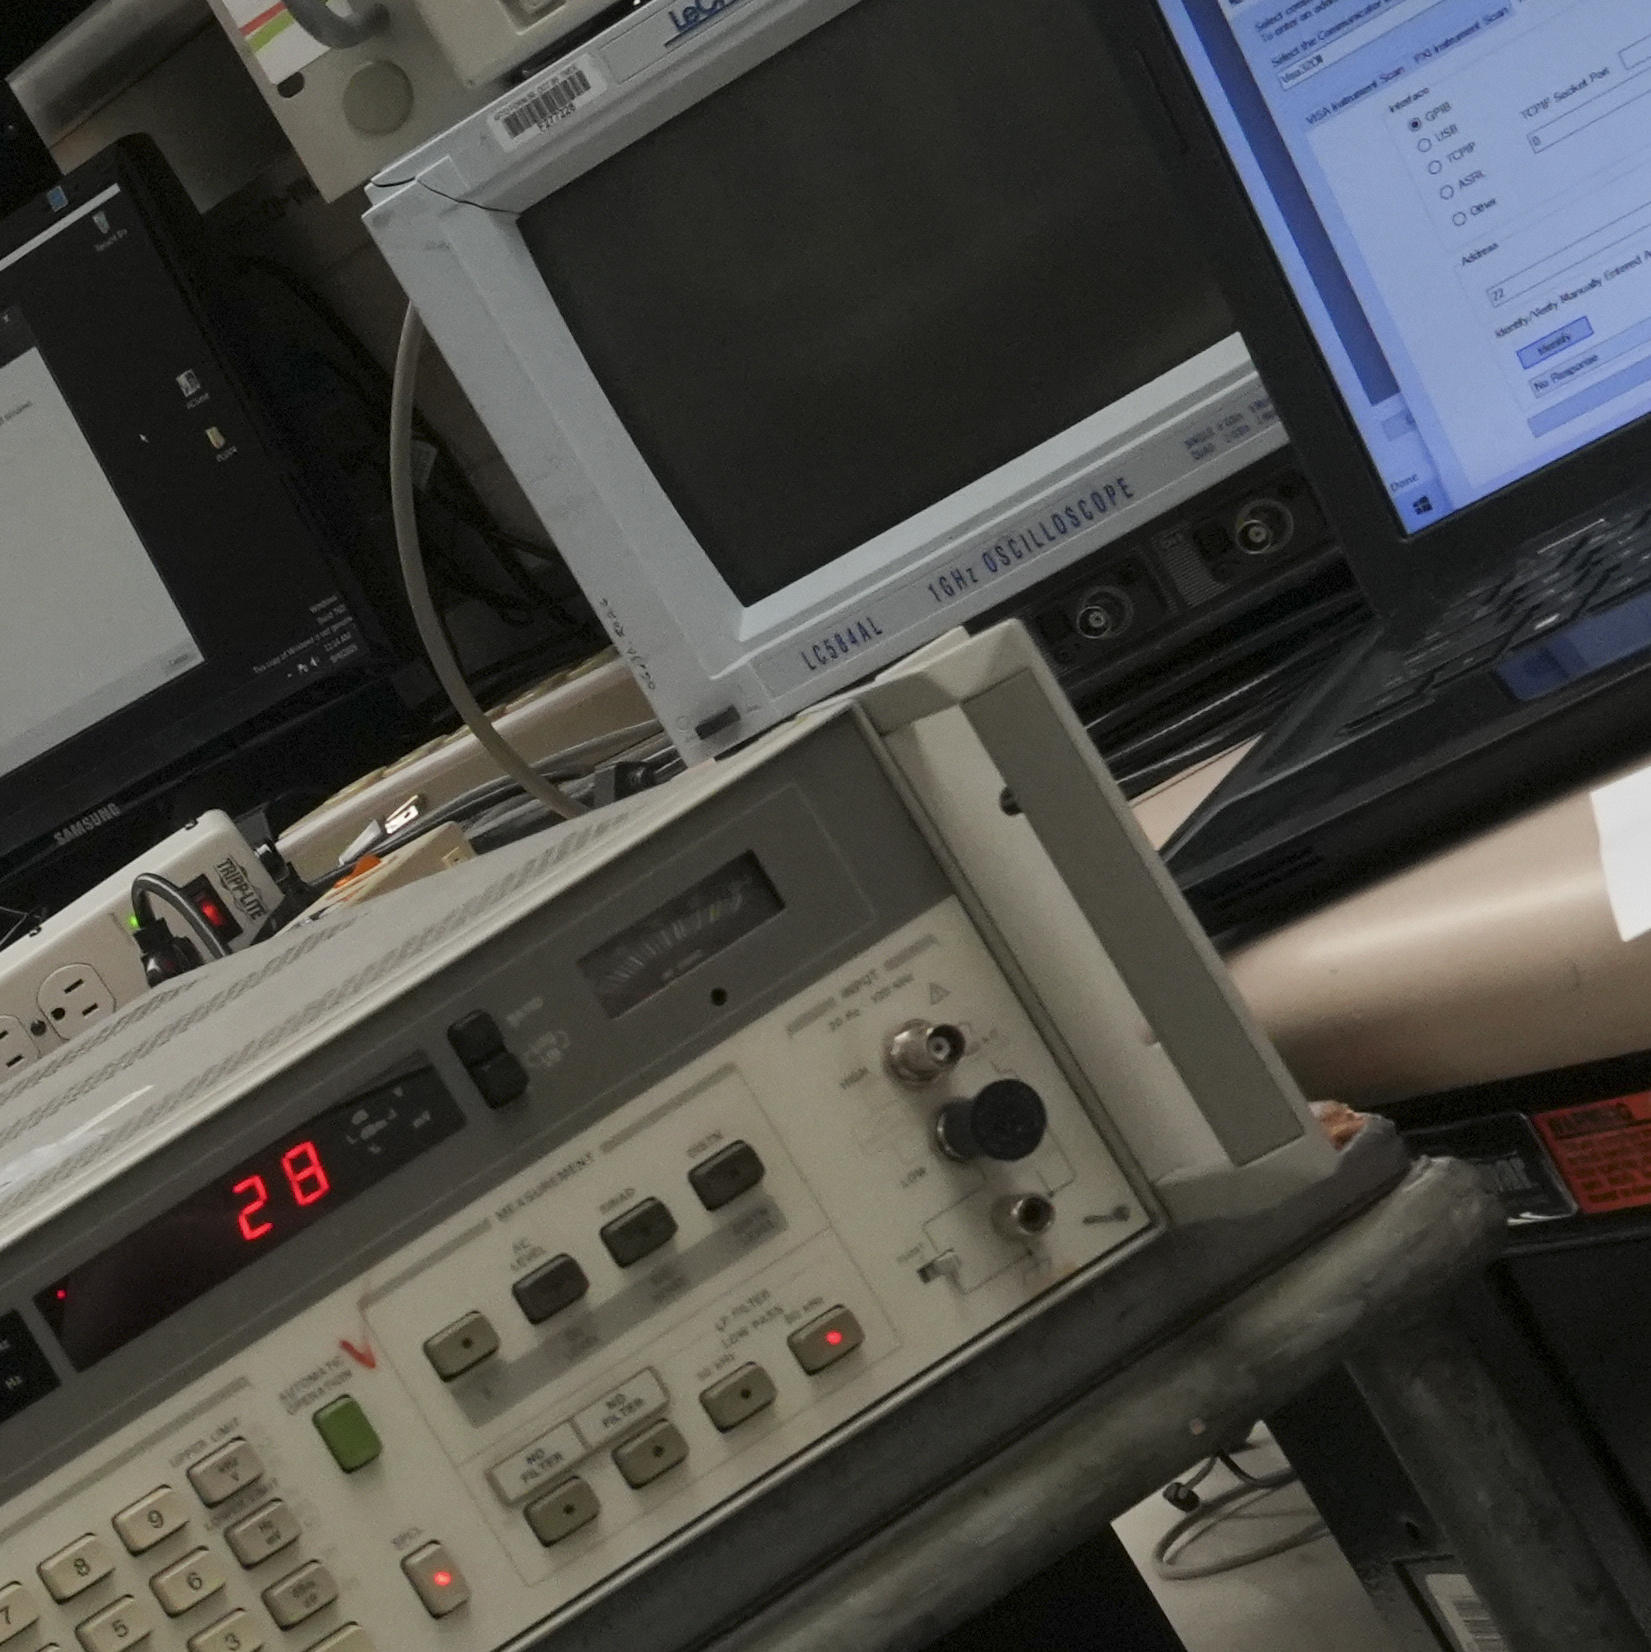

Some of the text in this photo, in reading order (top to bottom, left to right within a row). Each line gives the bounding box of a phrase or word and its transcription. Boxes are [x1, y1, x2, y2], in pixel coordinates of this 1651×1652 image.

[1481, 4, 1509, 26] Scan
[1269, 35, 1317, 68] Select the
[1305, 104, 1332, 125] VISA
[1378, 63, 1406, 84] Scan
[1388, 85, 1430, 113] Interface
[1423, 100, 1453, 122] GPIB
[1434, 123, 1458, 142] USB
[1459, 240, 1499, 267] Address
[926, 475, 1136, 605] 1GHz OSCILLOSCOPE
[800, 612, 883, 672] LC584AL
[53, 799, 121, 848] SAMSUNG
[216, 857, 266, 921] TRIPP-LITE
[217, 1136, 340, 1244] 28
[490, 1150, 600, 1223] MEASUREMENT
[599, 1394, 647, 1430] FILTER
[603, 1390, 628, 1412] NO
[518, 1449, 566, 1485] FILTER
[523, 1445, 548, 1466] NO
[145, 1507, 167, 1531] 9
[70, 1555, 93, 1579] 8
[184, 1569, 205, 1592] 6
[109, 1616, 131, 1640] 5
[222, 1630, 243, 1652] 3
